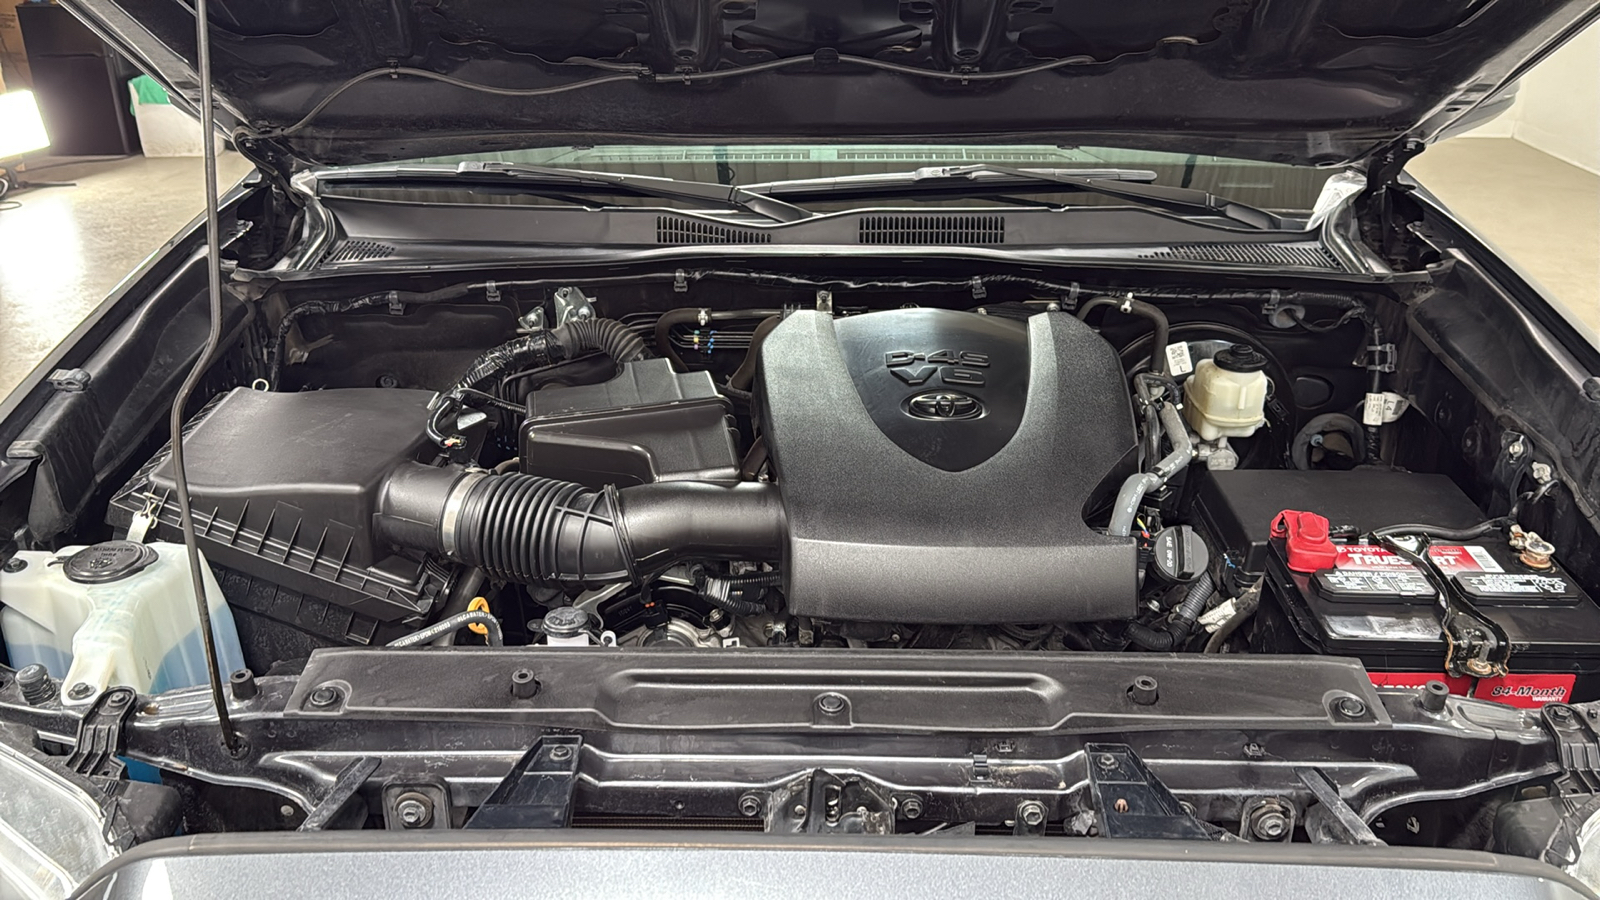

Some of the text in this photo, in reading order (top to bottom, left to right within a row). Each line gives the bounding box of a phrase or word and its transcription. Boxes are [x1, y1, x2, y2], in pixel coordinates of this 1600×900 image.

[884, 349, 990, 367] D-4S
[889, 366, 986, 386] V6
[1165, 536, 1173, 568] SAE 0W-20
[1491, 686, 1566, 697] 84-Month
